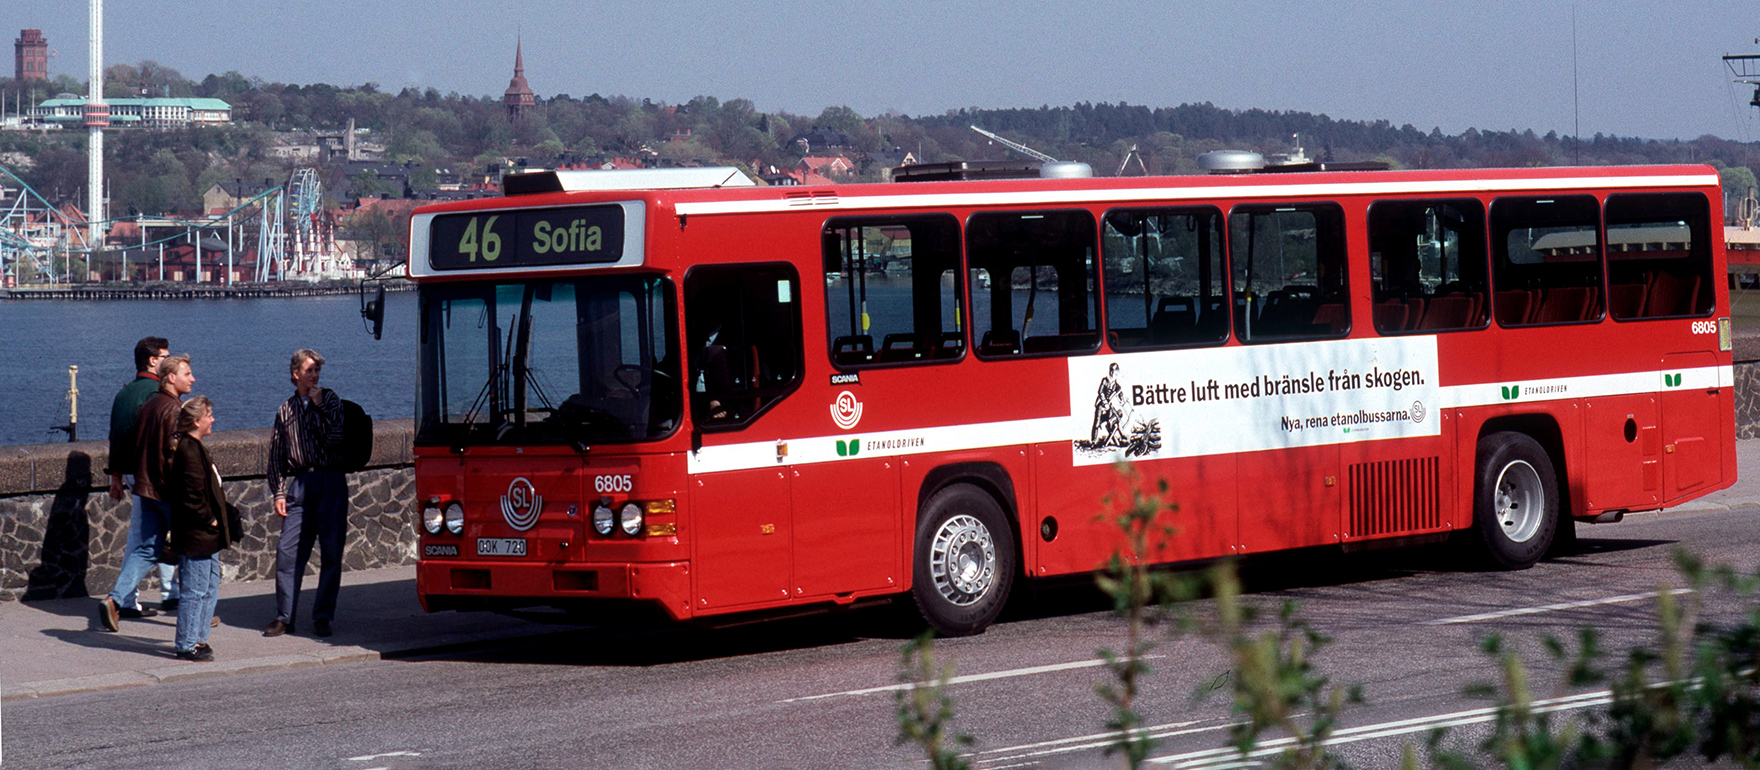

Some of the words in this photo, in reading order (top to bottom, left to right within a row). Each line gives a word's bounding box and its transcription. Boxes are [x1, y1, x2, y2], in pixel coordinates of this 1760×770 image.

[458, 215, 502, 262] 46
[532, 219, 602, 254] Sofia
[1691, 320, 1717, 335] 6805
[831, 374, 859, 384] SCANIA
[1132, 383, 1187, 406] Bättre
[1191, 379, 1220, 402] luft
[1224, 375, 1260, 400] med
[1264, 371, 1325, 396] bränsle
[1328, 369, 1361, 391] från
[1365, 366, 1425, 391] skogen.
[1281, 416, 1303, 432] Nya,
[1305, 416, 1328, 429] rena
[1330, 409, 1411, 426] etanolbussarna.
[867, 437, 925, 451] ETANOLDRIVEN
[594, 474, 633, 493] 6805
[425, 545, 458, 556] SCANIA
